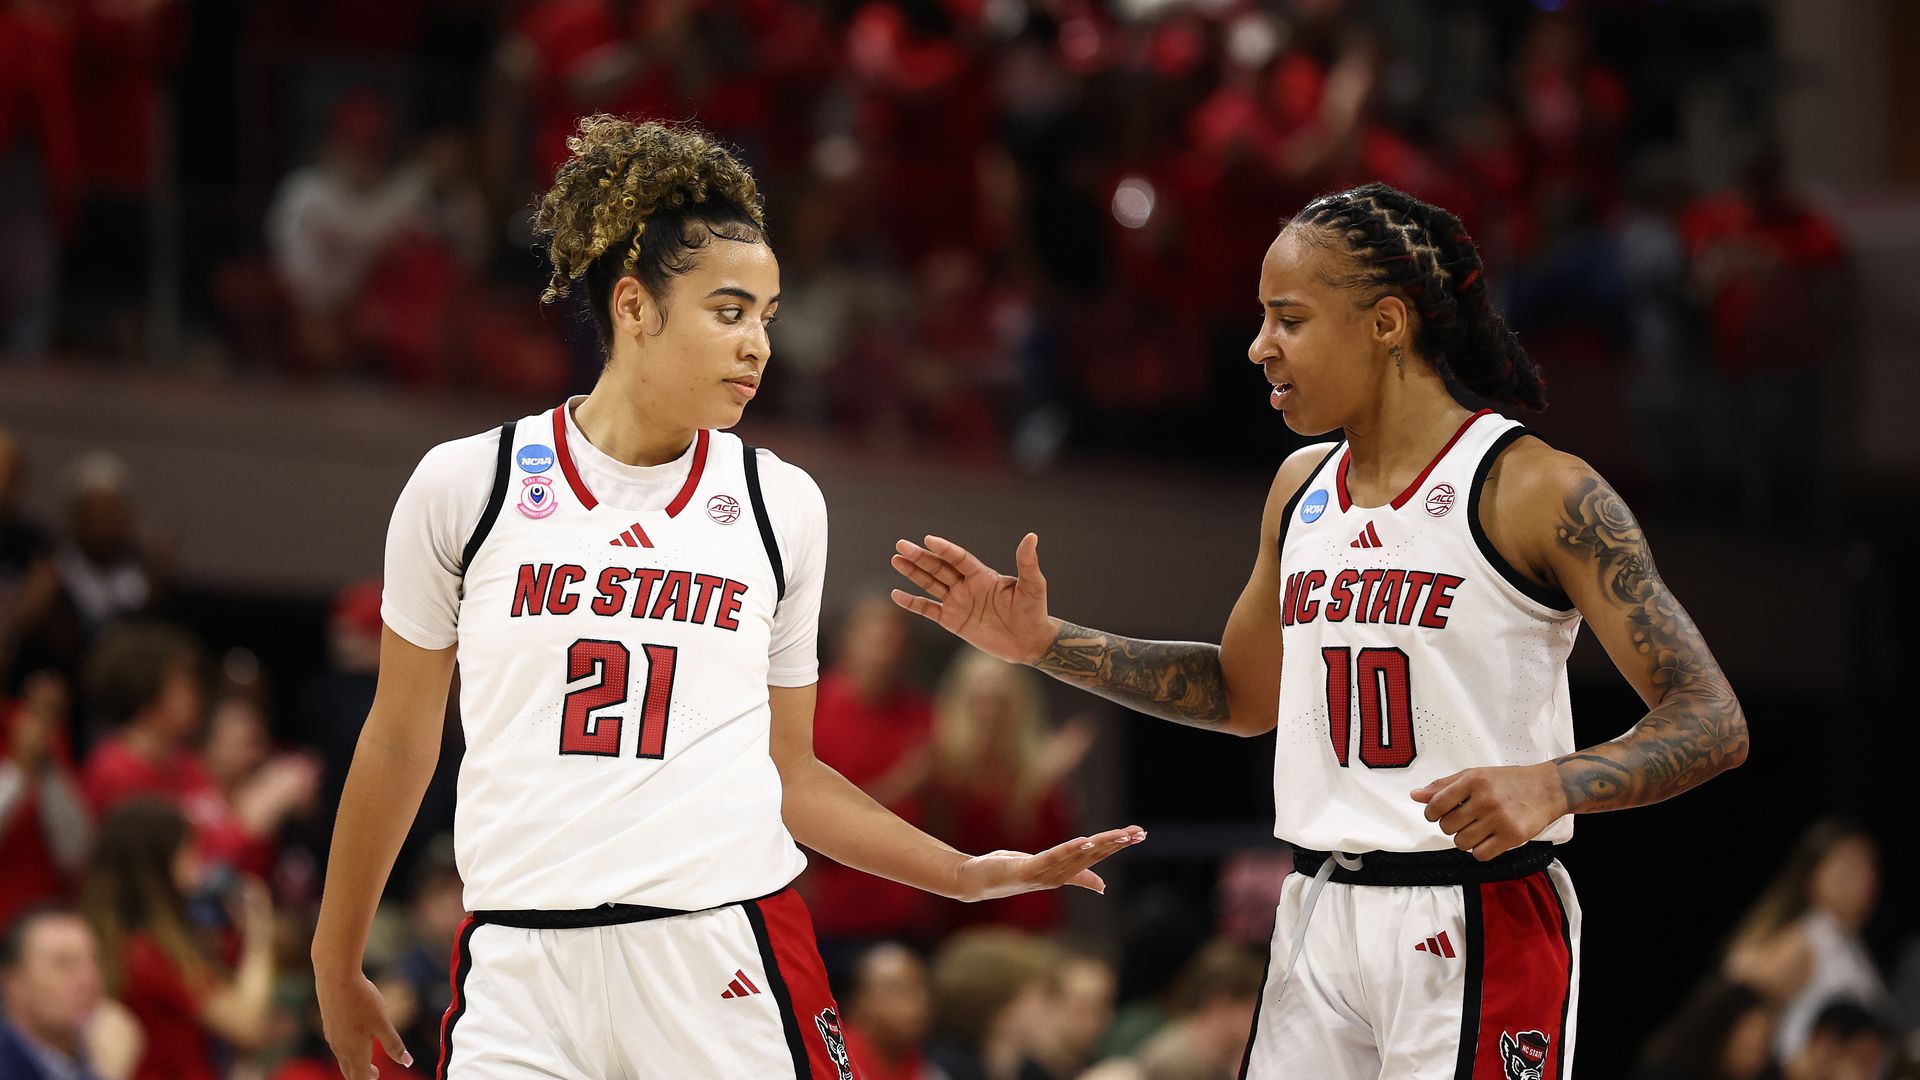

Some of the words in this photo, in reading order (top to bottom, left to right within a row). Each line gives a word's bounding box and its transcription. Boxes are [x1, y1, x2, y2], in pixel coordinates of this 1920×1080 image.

[521, 457, 552, 466] NCAA
[711, 504, 739, 512] ACC
[1430, 494, 1455, 503] ACC
[510, 563, 586, 617] NC
[590, 566, 749, 632] STATE
[1282, 569, 1327, 629] NC
[1325, 568, 1466, 629] STATE
[559, 638, 678, 760] 21
[1321, 646, 1417, 769] 10
[1522, 1044, 1530, 1054] NC
